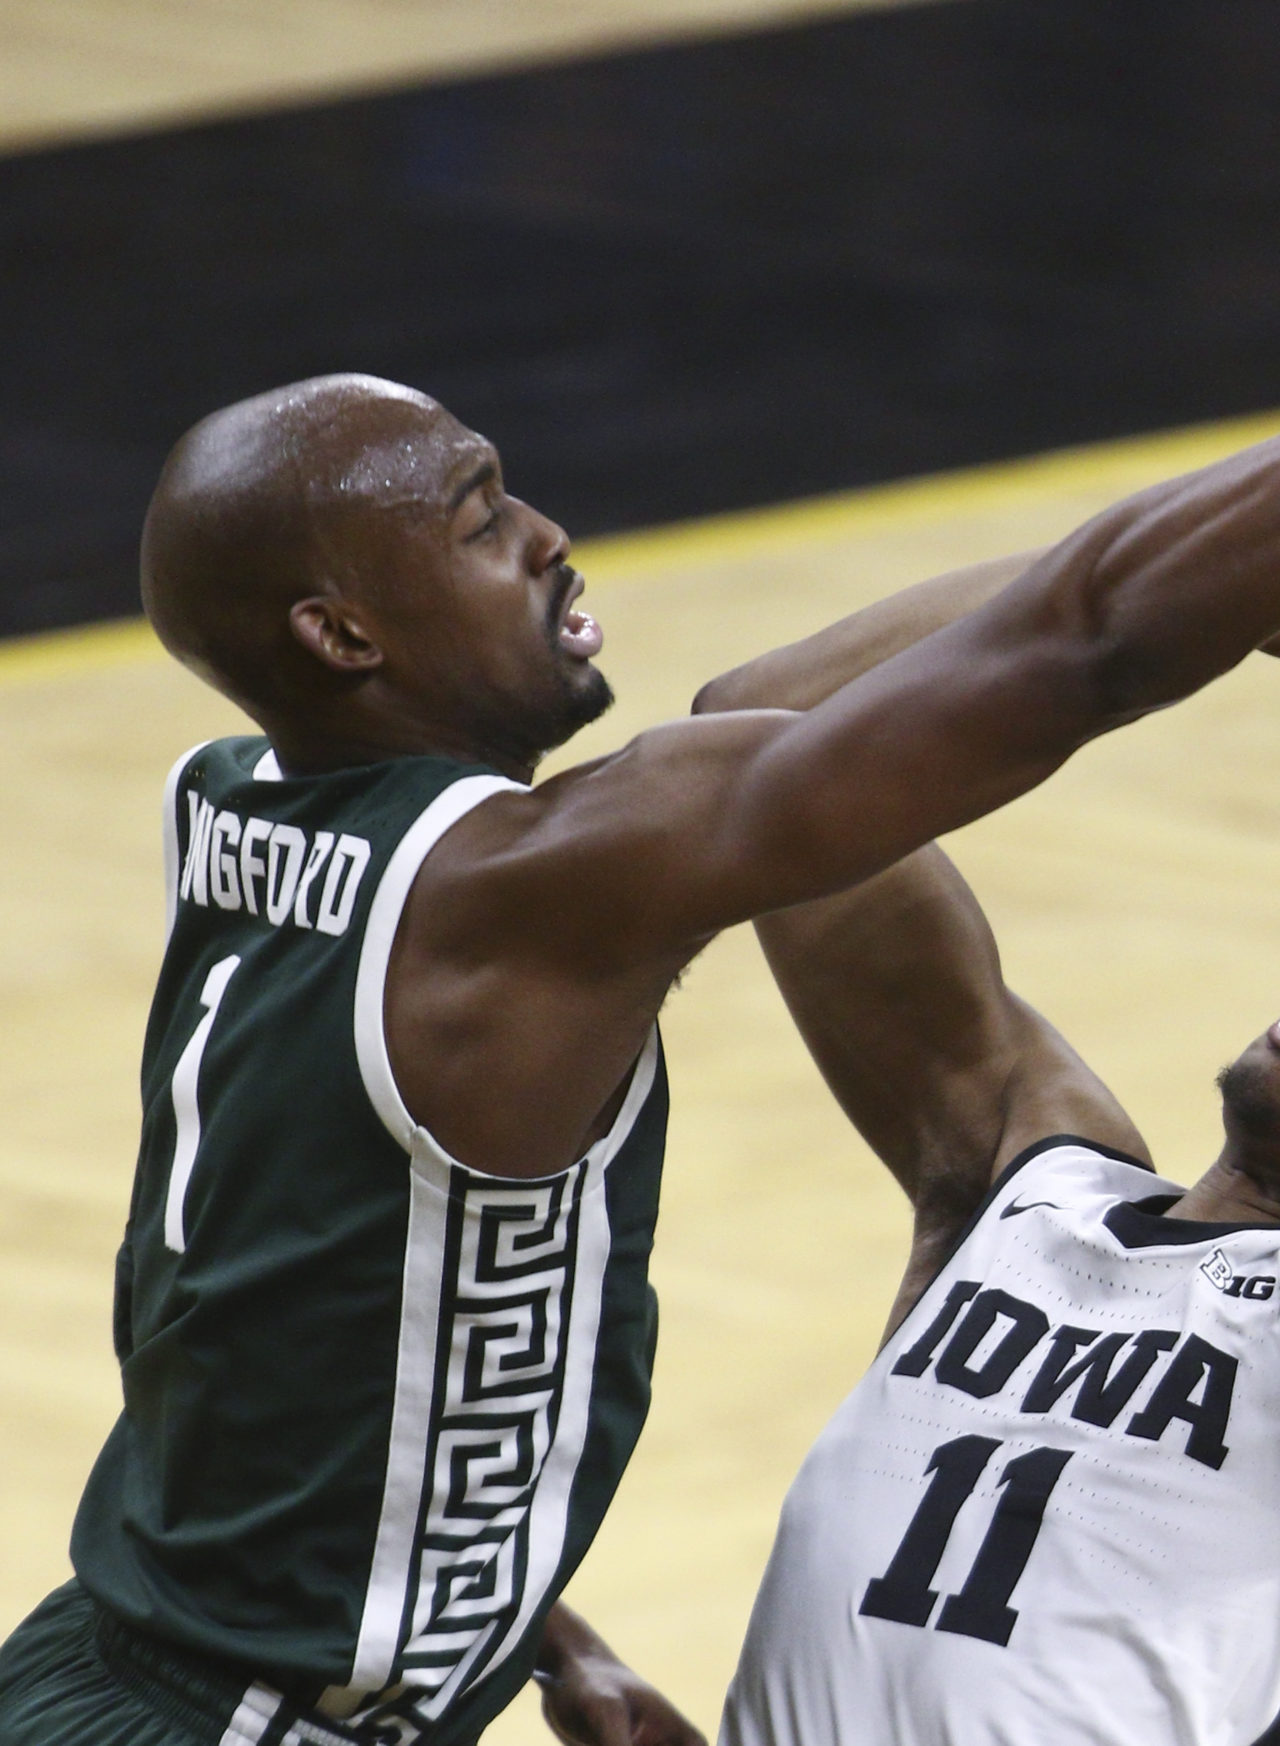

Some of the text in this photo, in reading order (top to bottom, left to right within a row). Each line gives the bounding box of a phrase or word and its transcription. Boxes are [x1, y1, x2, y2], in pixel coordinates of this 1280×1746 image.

[164, 954, 241, 1254] 1
[891, 1281, 1239, 1471] IOWA
[858, 1434, 1075, 1647] 11
